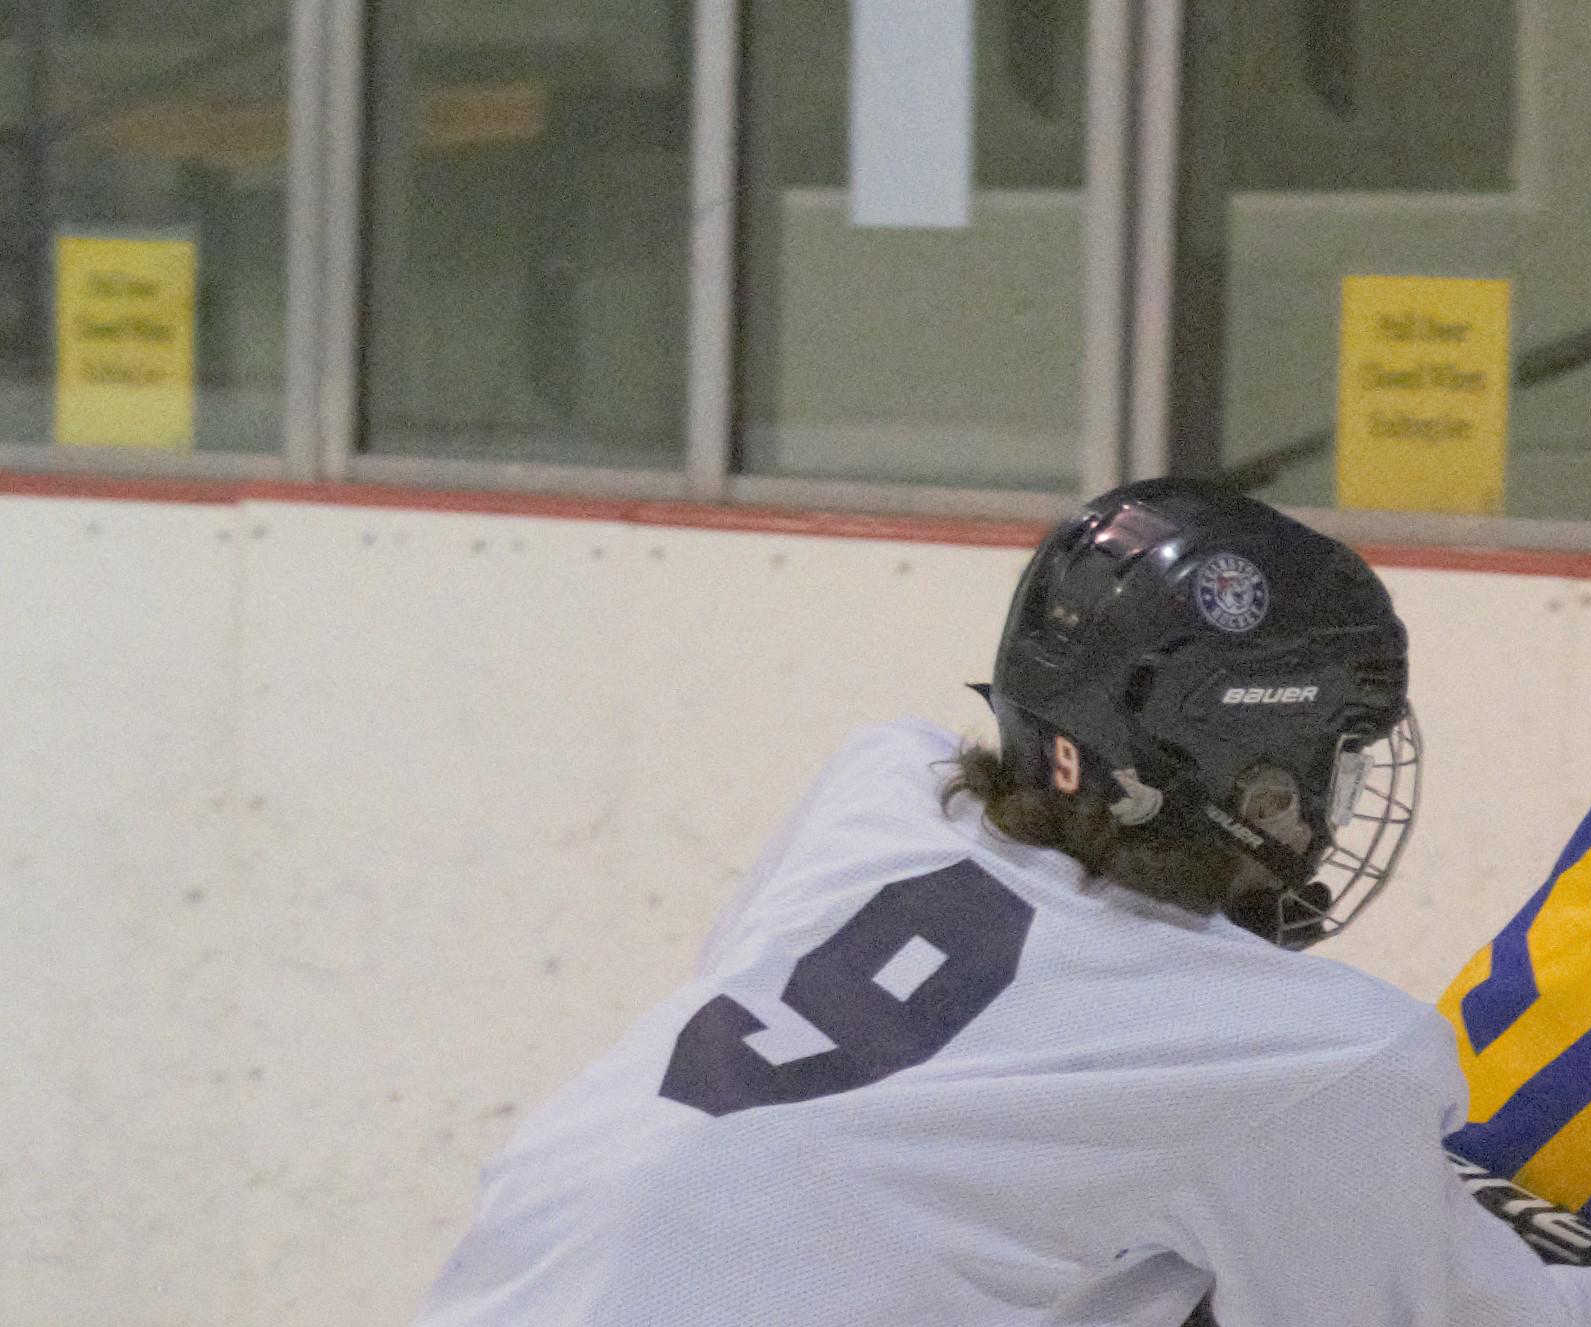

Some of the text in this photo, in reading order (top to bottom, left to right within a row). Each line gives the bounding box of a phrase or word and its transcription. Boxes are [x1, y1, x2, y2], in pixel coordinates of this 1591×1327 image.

[1222, 685, 1320, 705] BAUER
[1054, 734, 1081, 793] 9
[657, 857, 1037, 1119] 9
